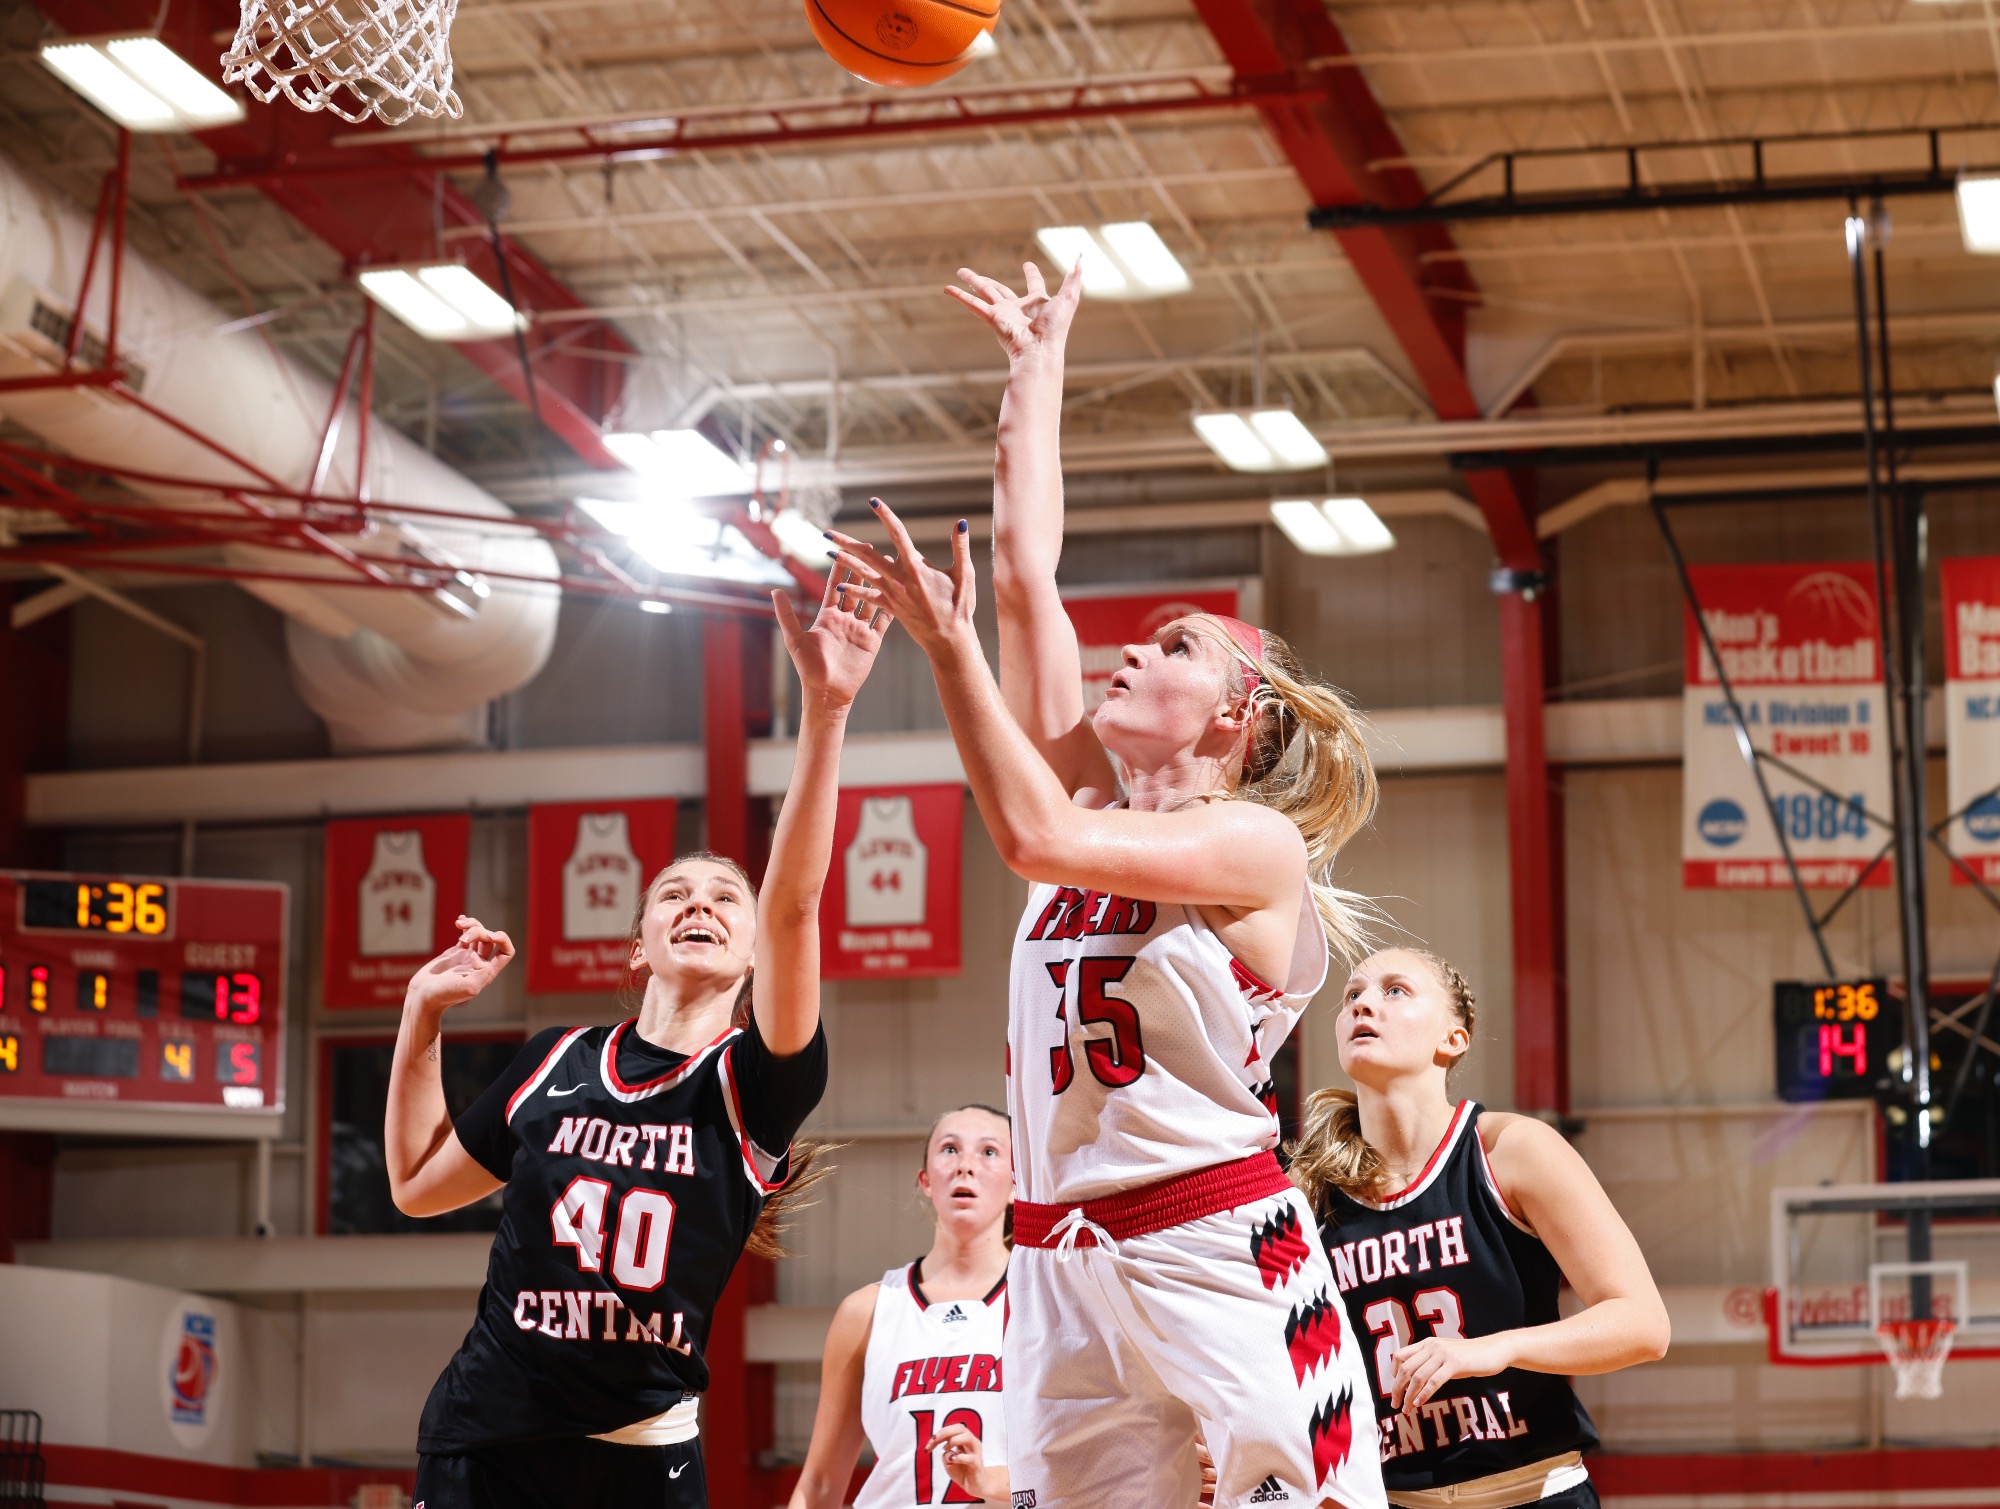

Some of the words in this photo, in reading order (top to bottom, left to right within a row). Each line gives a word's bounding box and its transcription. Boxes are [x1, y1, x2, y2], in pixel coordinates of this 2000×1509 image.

[1772, 793, 1868, 839] 1984
[77, 882, 166, 935] 1:36
[185, 943, 257, 968] GUEST
[94, 974, 107, 1010] 1
[215, 973, 261, 1024] 13
[1814, 984, 1879, 1021] 1:36
[164, 1043, 191, 1079] 4
[230, 1043, 257, 1084] 5
[1819, 1023, 1867, 1077] 14
[547, 1116, 695, 1176] NORTH
[550, 1174, 677, 1292] 40
[1330, 1215, 1470, 1293] NORTH
[1362, 1285, 1468, 1399] 23
[1250, 1491, 1289, 1503] adidas
